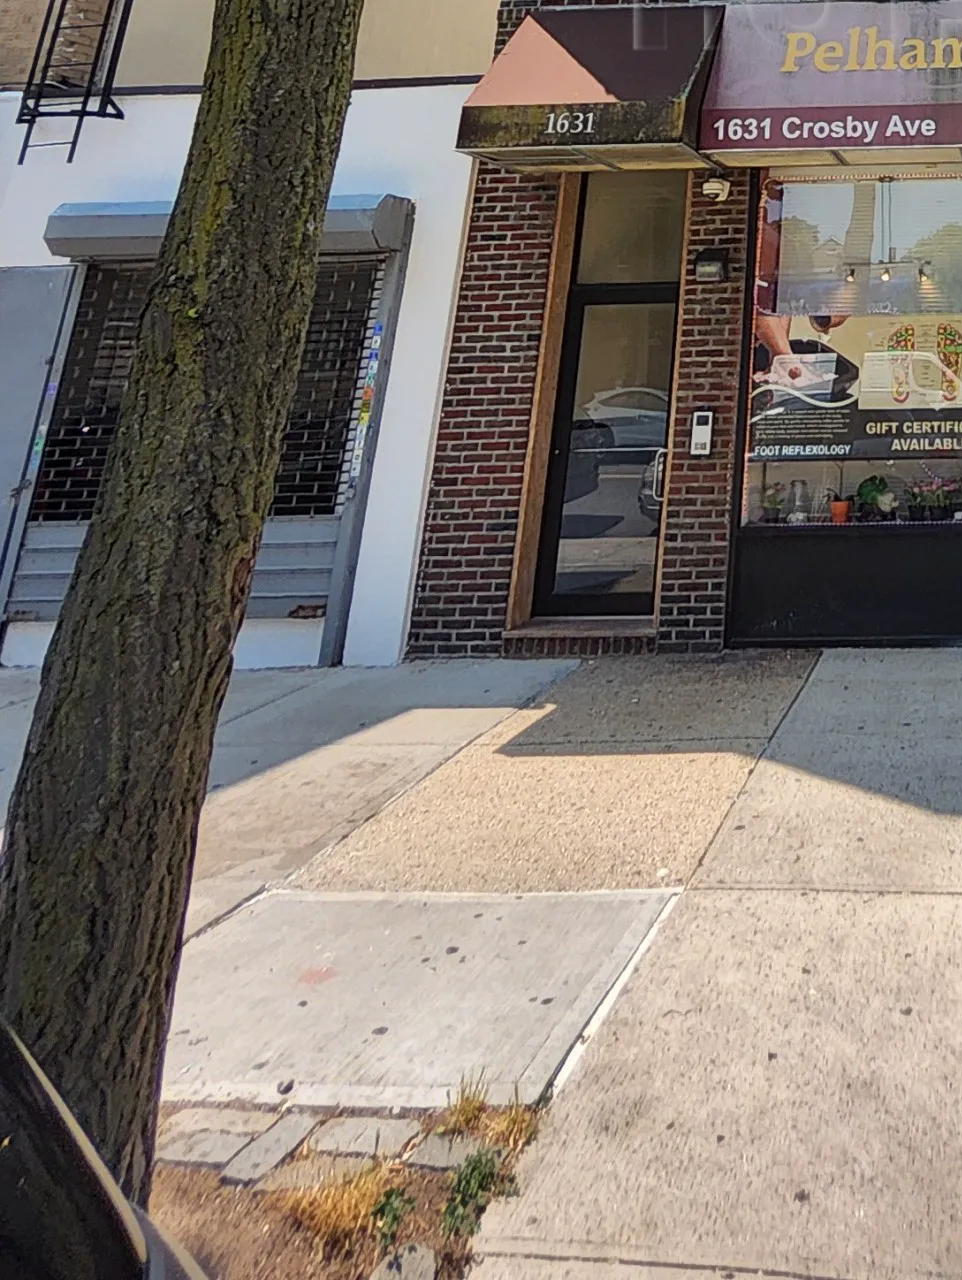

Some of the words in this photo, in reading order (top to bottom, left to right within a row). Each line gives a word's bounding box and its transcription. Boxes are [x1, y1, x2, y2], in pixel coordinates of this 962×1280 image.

[544, 112, 596, 135] 1631
[713, 117, 771, 141] 1631
[782, 116, 878, 143] Crosby
[885, 115, 936, 137] Ave
[865, 421, 899, 435] GIFT
[754, 445, 780, 456] FOOT
[782, 444, 852, 456] REFLEXOLOGY
